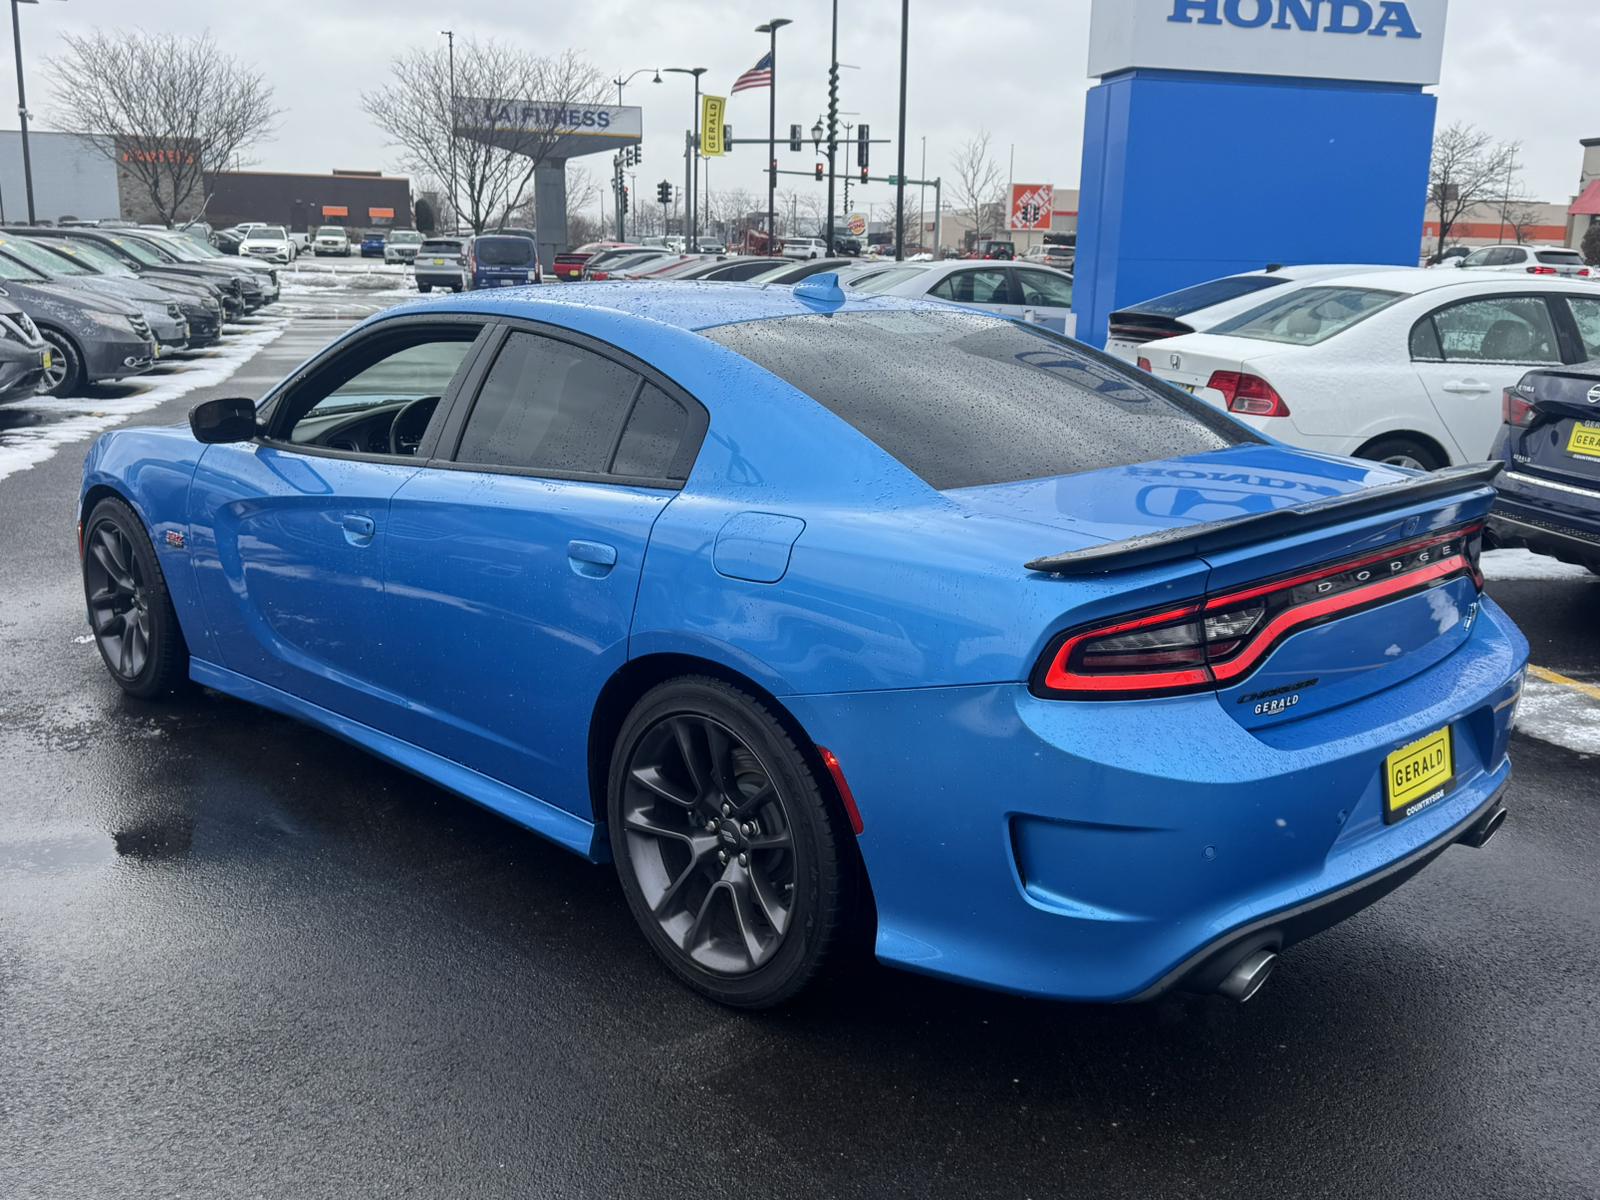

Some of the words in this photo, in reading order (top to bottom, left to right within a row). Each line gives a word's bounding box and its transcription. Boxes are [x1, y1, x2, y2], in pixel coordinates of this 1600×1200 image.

[1167, 0, 1422, 39] HONDA
[522, 107, 610, 128] FITNESS
[708, 103, 718, 149] GERALD
[1576, 434, 1600, 448] GERA
[1318, 545, 1451, 592] DODGE
[1254, 694, 1299, 714] GERALD
[1395, 748, 1442, 787] GERALD
[1406, 789, 1445, 816] COUNTRYSIDE
